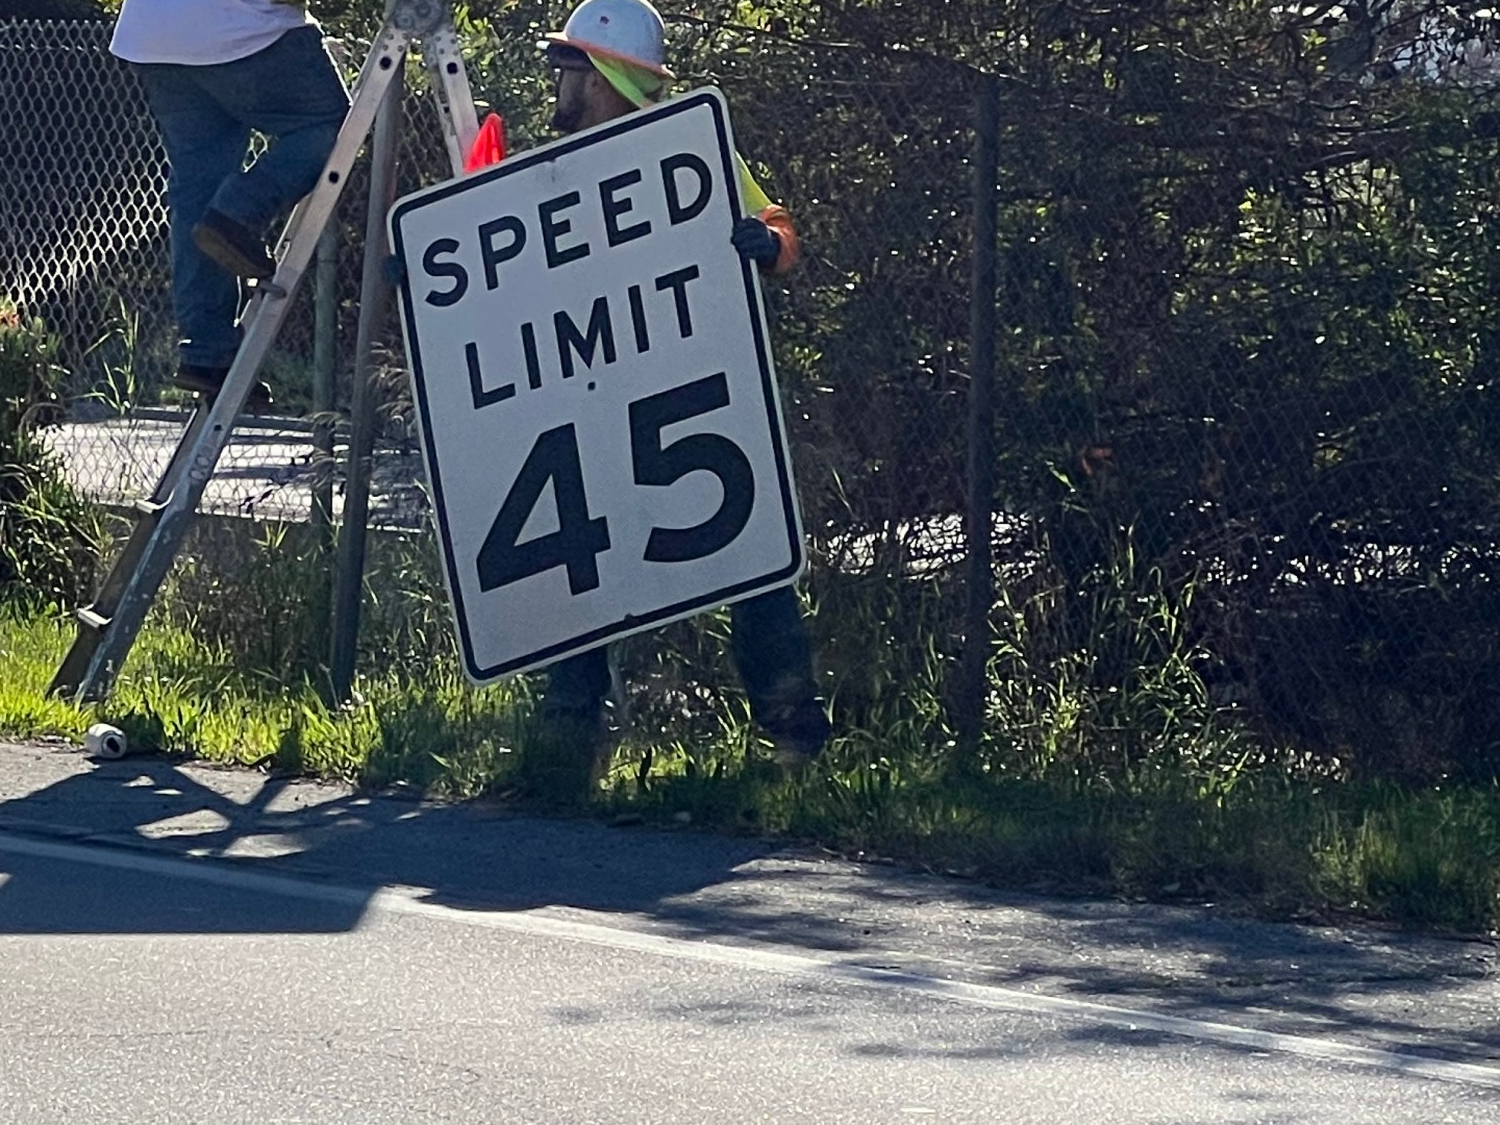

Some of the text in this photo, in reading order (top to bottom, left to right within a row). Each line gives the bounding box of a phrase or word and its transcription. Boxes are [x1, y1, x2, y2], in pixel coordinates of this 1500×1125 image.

[422, 152, 713, 307] SPEED
[464, 265, 701, 410] LIMIT
[476, 372, 755, 596] 45
